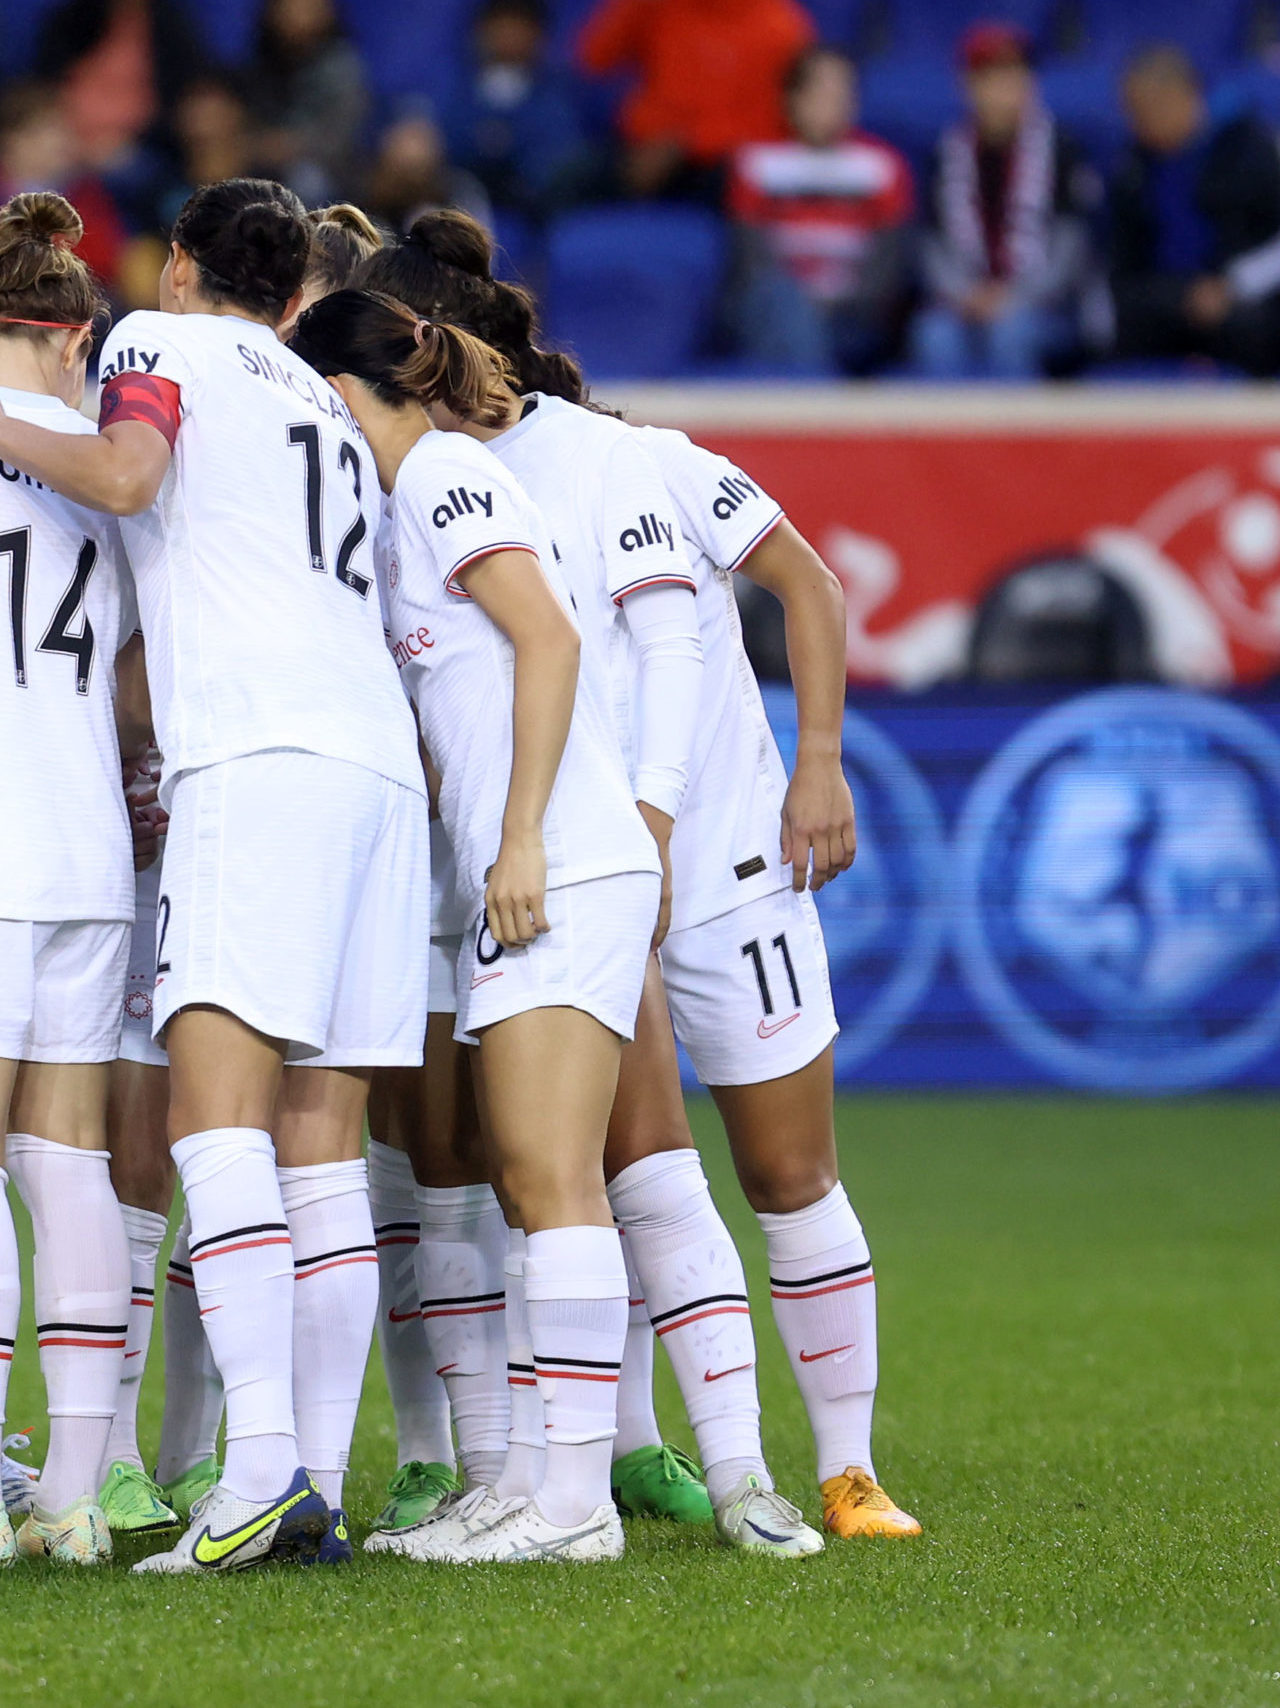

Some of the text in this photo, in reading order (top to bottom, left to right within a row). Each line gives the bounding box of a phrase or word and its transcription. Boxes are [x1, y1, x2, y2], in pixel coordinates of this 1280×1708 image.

[100, 347, 160, 384] ally
[286, 421, 374, 600] 12
[432, 486, 493, 529] ally
[713, 471, 758, 520] ally
[620, 513, 674, 552] ally
[741, 931, 802, 1017] 11
